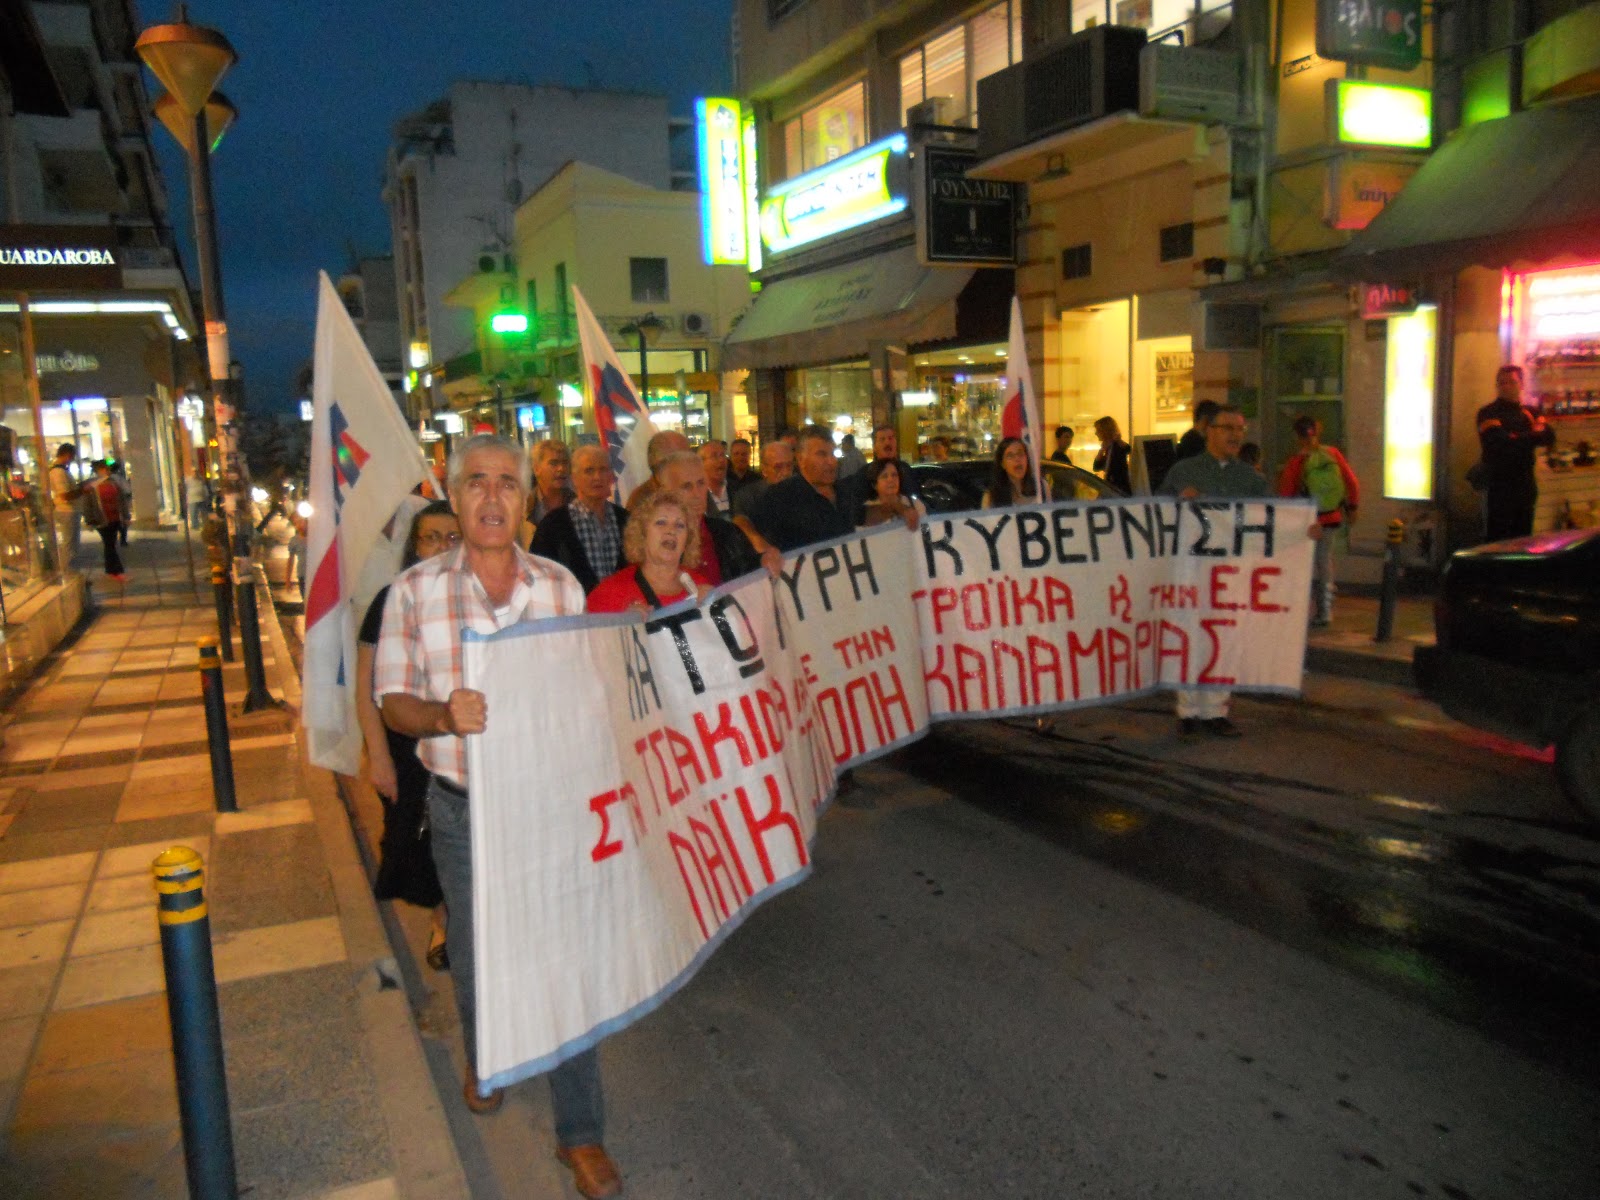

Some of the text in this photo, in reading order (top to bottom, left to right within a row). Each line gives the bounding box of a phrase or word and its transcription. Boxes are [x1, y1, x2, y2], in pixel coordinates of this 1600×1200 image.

[0, 248, 116, 265] UARDAROBA
[921, 502, 1275, 578] ΚΥΒΕΡΝΗΣΗ
[833, 624, 896, 669] ΤΗΝ
[911, 573, 1075, 635] ΤΡΟΪΚΑ
